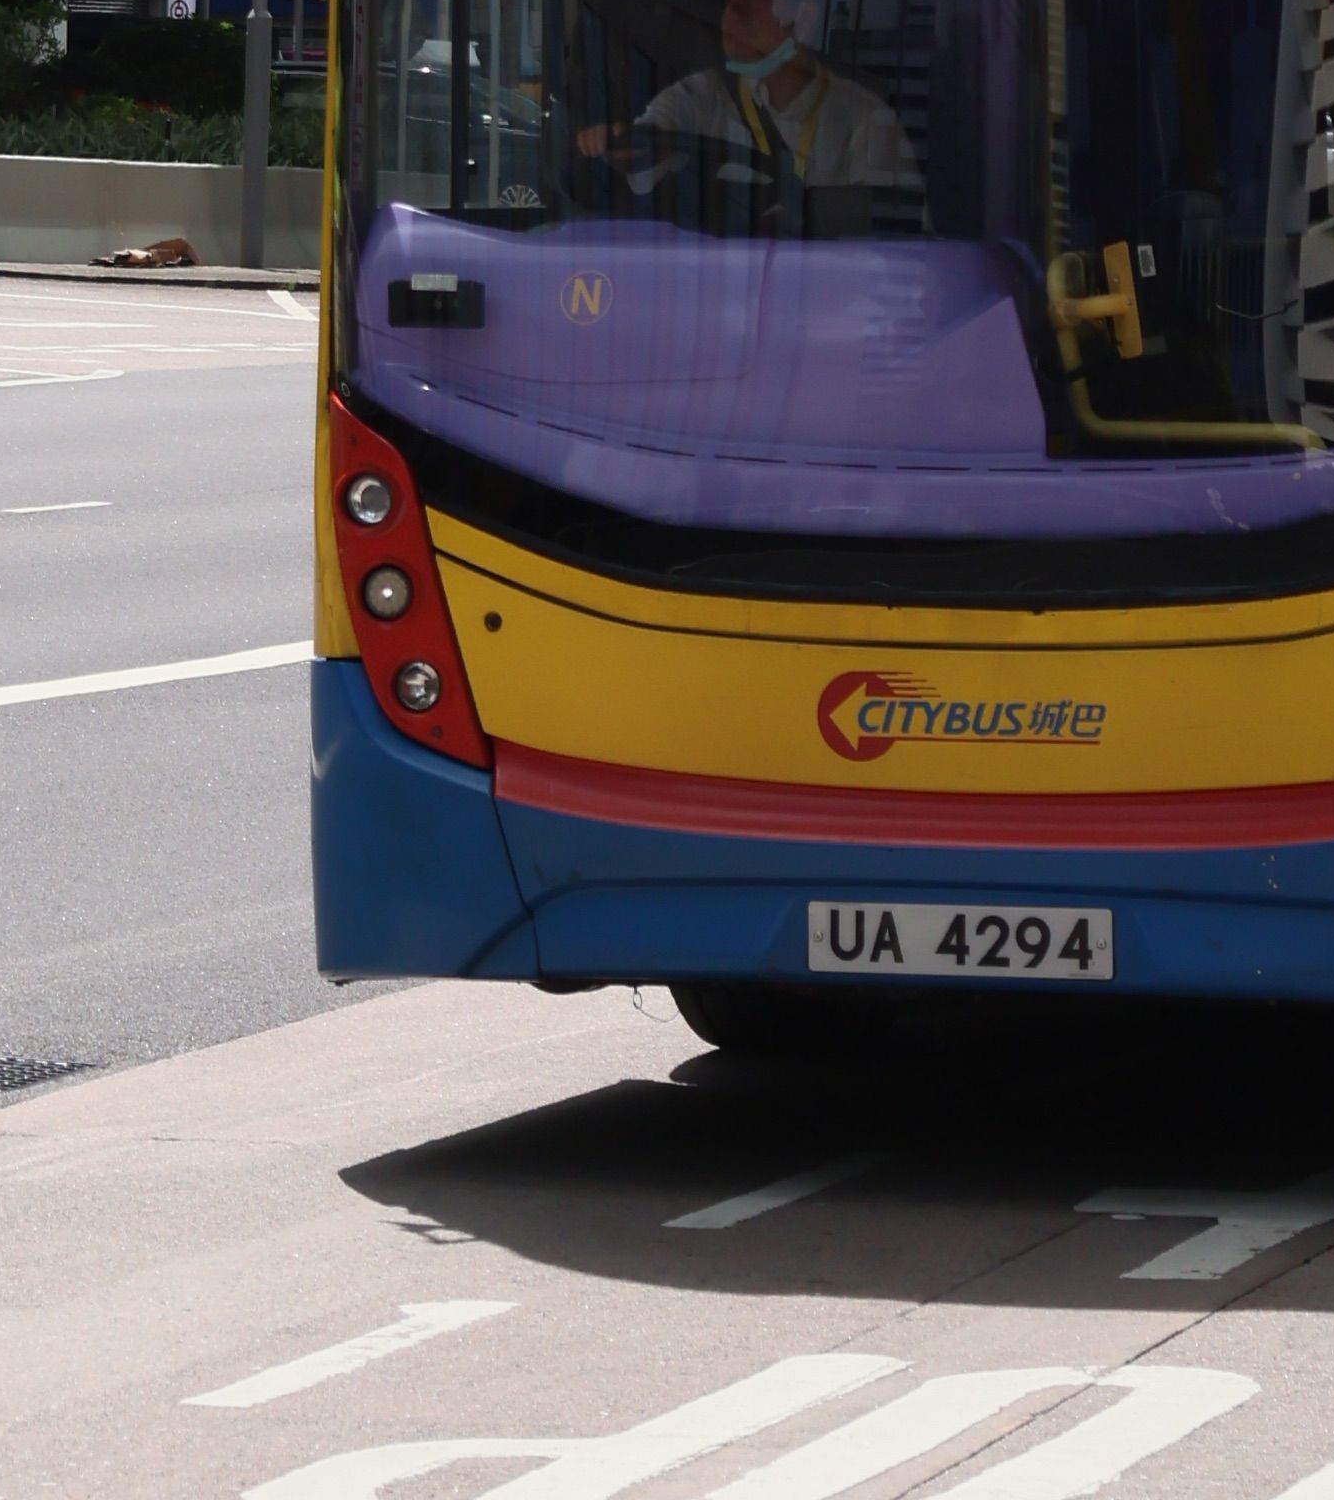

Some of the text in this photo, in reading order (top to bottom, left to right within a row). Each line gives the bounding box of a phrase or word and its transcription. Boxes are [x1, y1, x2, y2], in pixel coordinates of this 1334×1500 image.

[570, 276, 603, 316] N
[857, 699, 1107, 738] CITYBUS 城巴
[829, 903, 1095, 970] UA 4294
